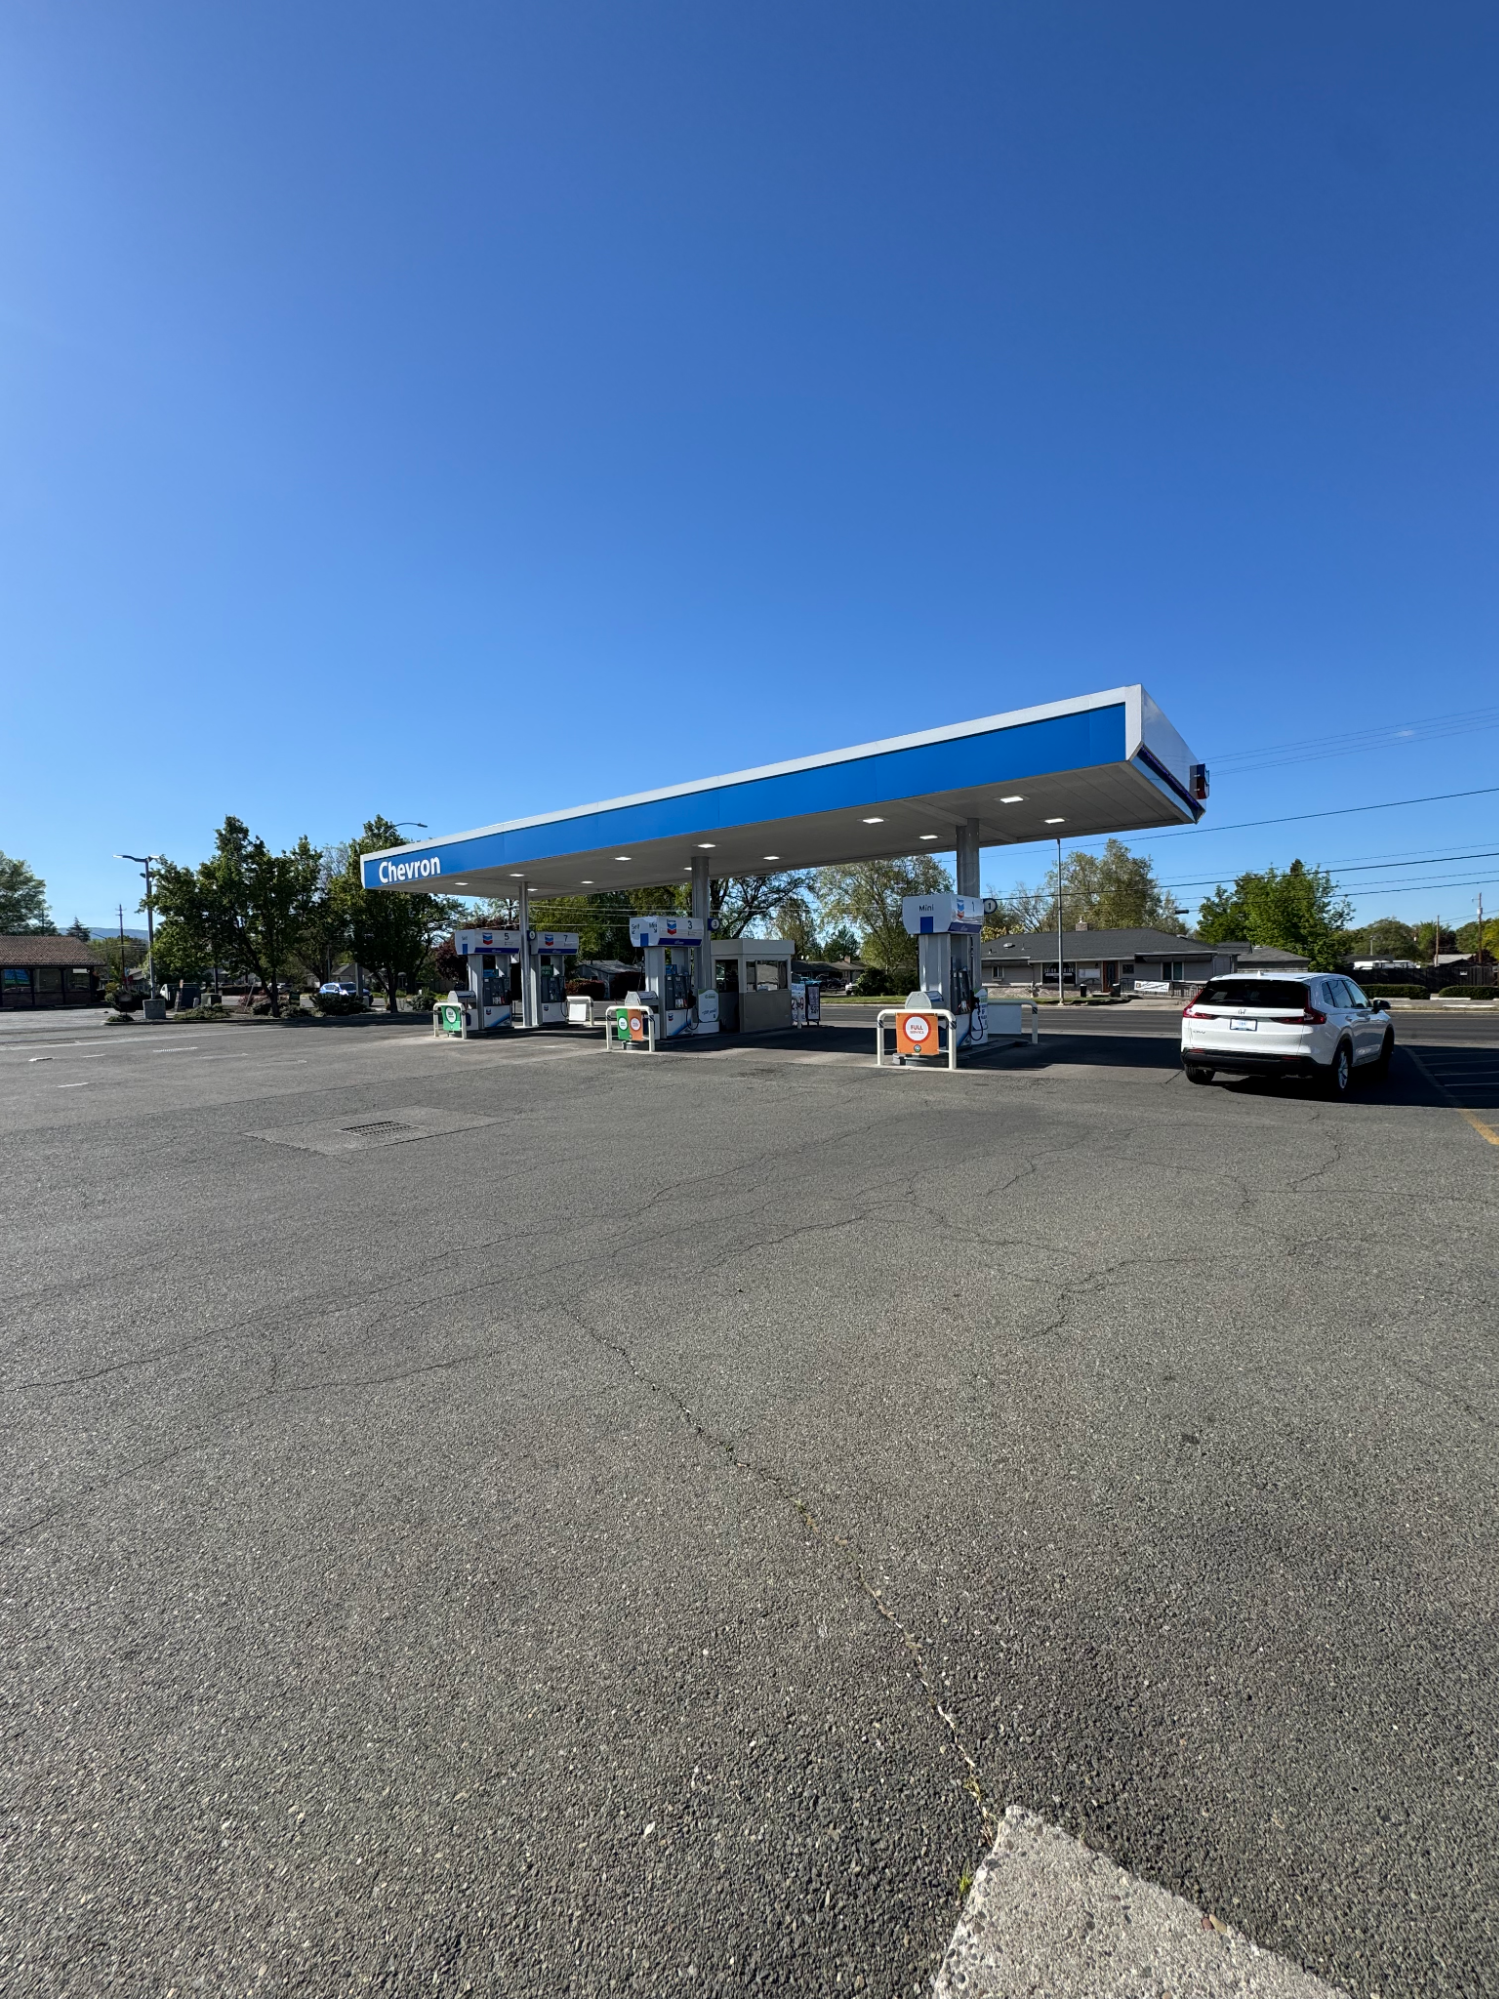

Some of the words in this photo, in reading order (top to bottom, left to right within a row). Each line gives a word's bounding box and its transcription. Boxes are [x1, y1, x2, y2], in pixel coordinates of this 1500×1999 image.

[378, 857, 441, 884] Chevron
[919, 904, 934, 912] Mini
[688, 920, 693, 930] 3
[504, 932, 510, 941] 5
[563, 934, 568, 942] 7
